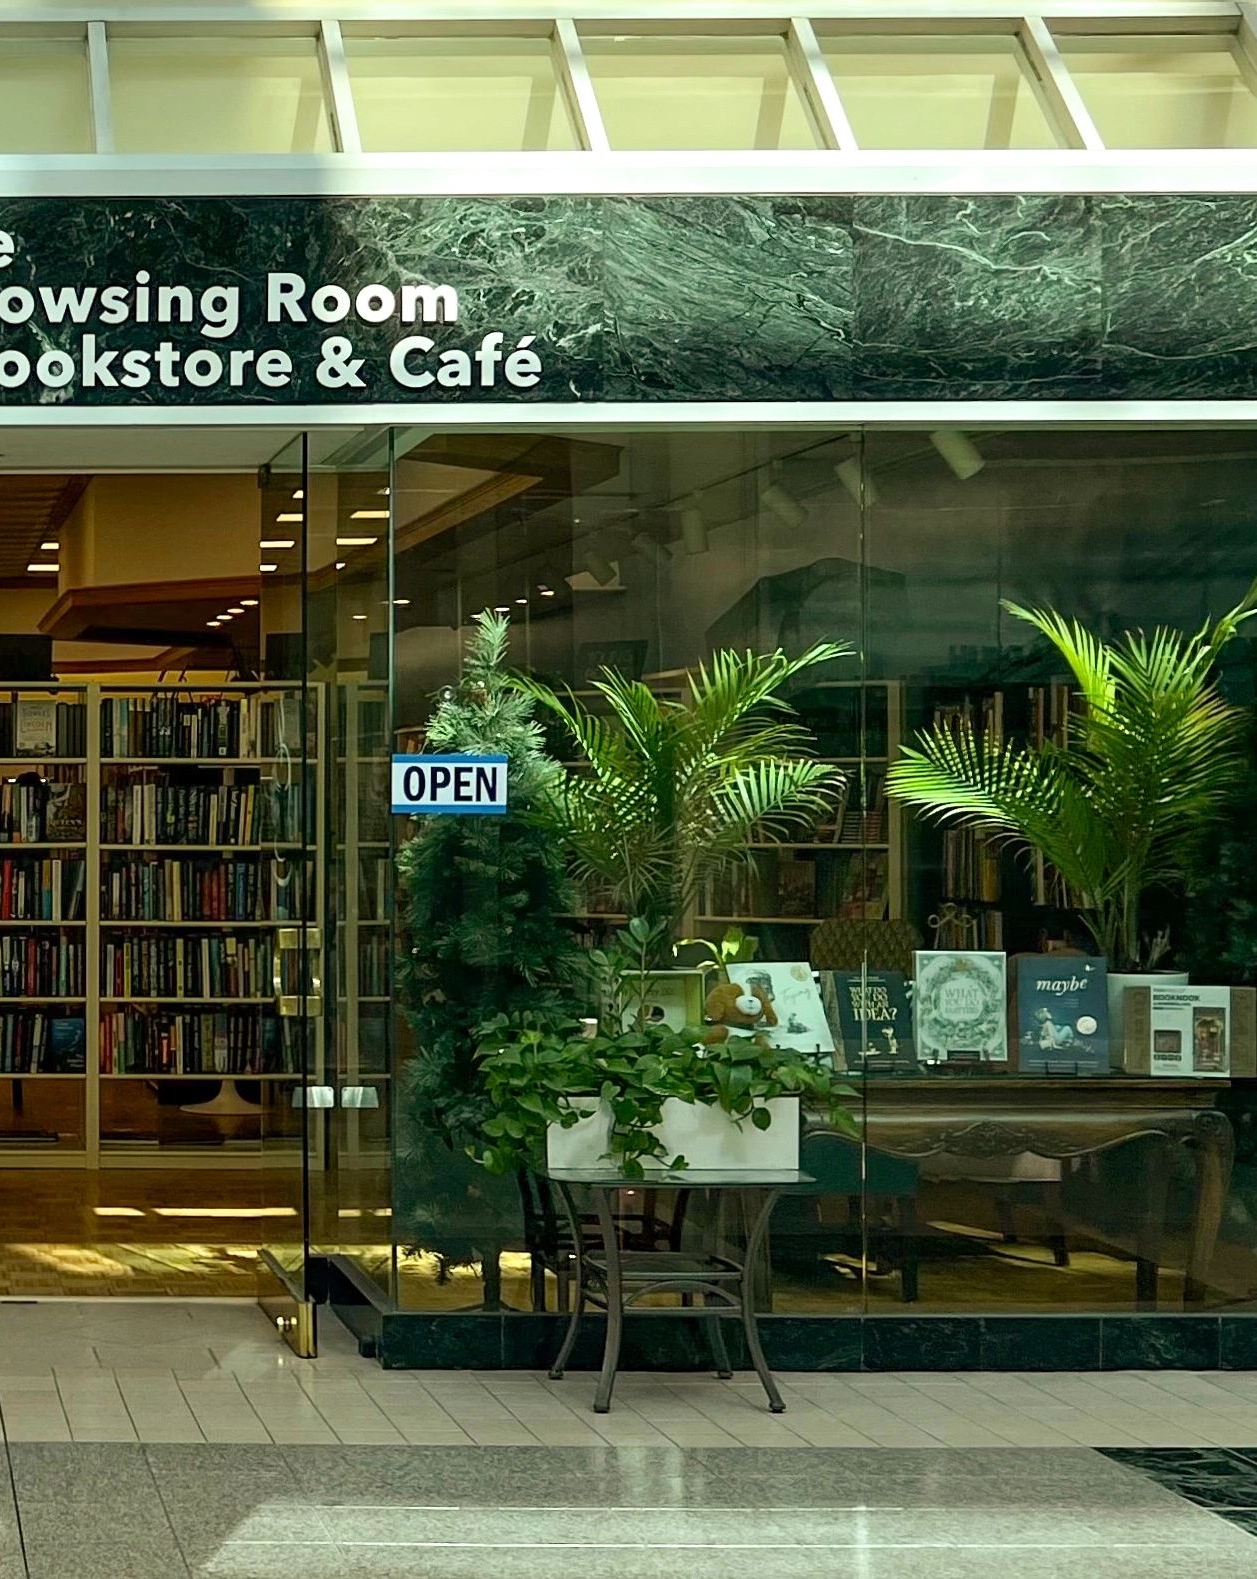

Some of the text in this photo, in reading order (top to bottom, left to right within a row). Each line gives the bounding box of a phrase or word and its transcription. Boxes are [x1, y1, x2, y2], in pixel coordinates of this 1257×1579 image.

[266, 272, 459, 324] Room
[315, 335, 367, 389] &
[389, 331, 543, 389] Café
[403, 765, 498, 802] OPEN
[945, 988, 979, 999] WHAT
[1036, 976, 1088, 996] maybe
[853, 1007, 898, 1021] IDEA?
